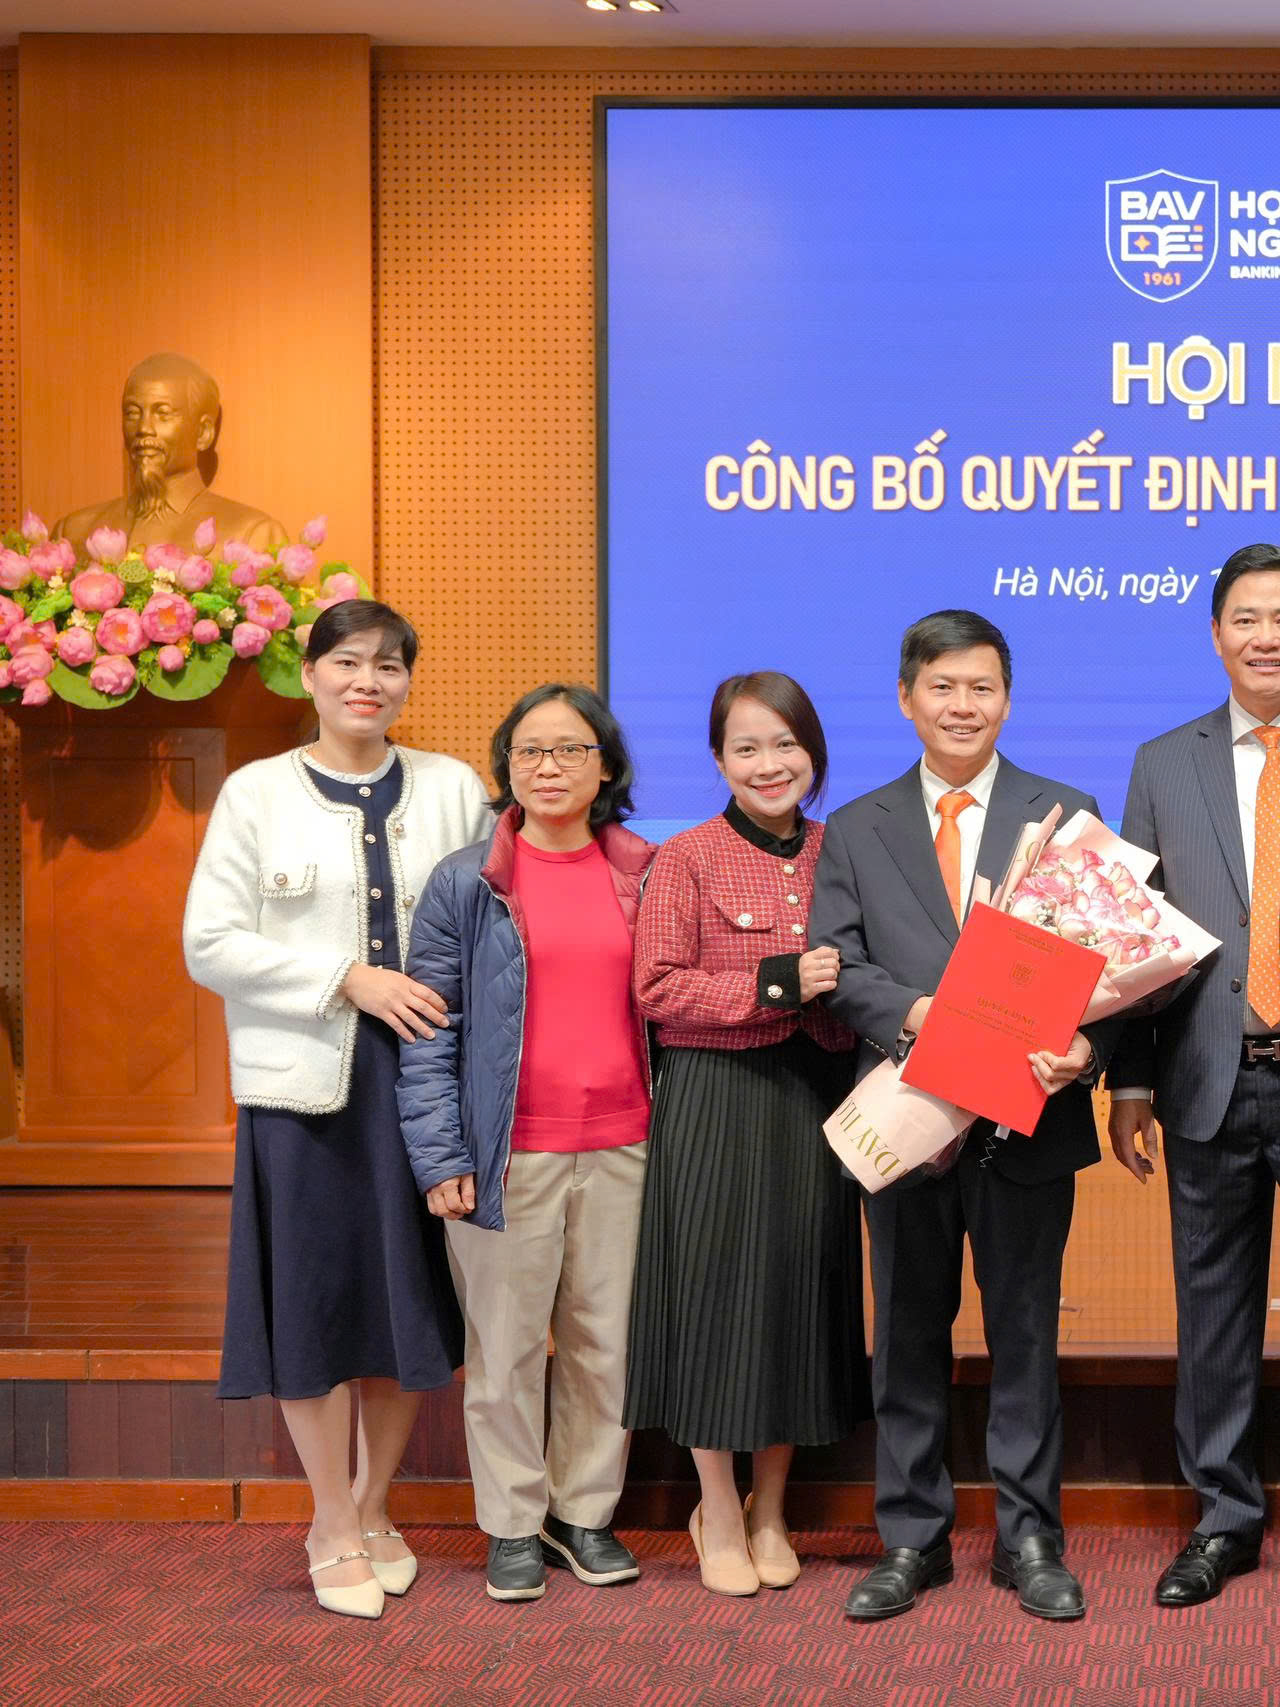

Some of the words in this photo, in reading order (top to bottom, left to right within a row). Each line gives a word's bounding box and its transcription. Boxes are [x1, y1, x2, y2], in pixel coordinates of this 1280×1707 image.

[1121, 191, 1205, 220] BAV
[1144, 272, 1181, 286] 1961
[1113, 335, 1245, 419] HỘI
[705, 439, 854, 510] CÔNG
[872, 429, 947, 510] BỐ
[962, 430, 1132, 511] QUYẾT
[1144, 456, 1276, 526] ĐỊNH
[994, 567, 1038, 596] Hà
[1049, 567, 1108, 601] Nội,
[1120, 567, 1199, 603] ngày
